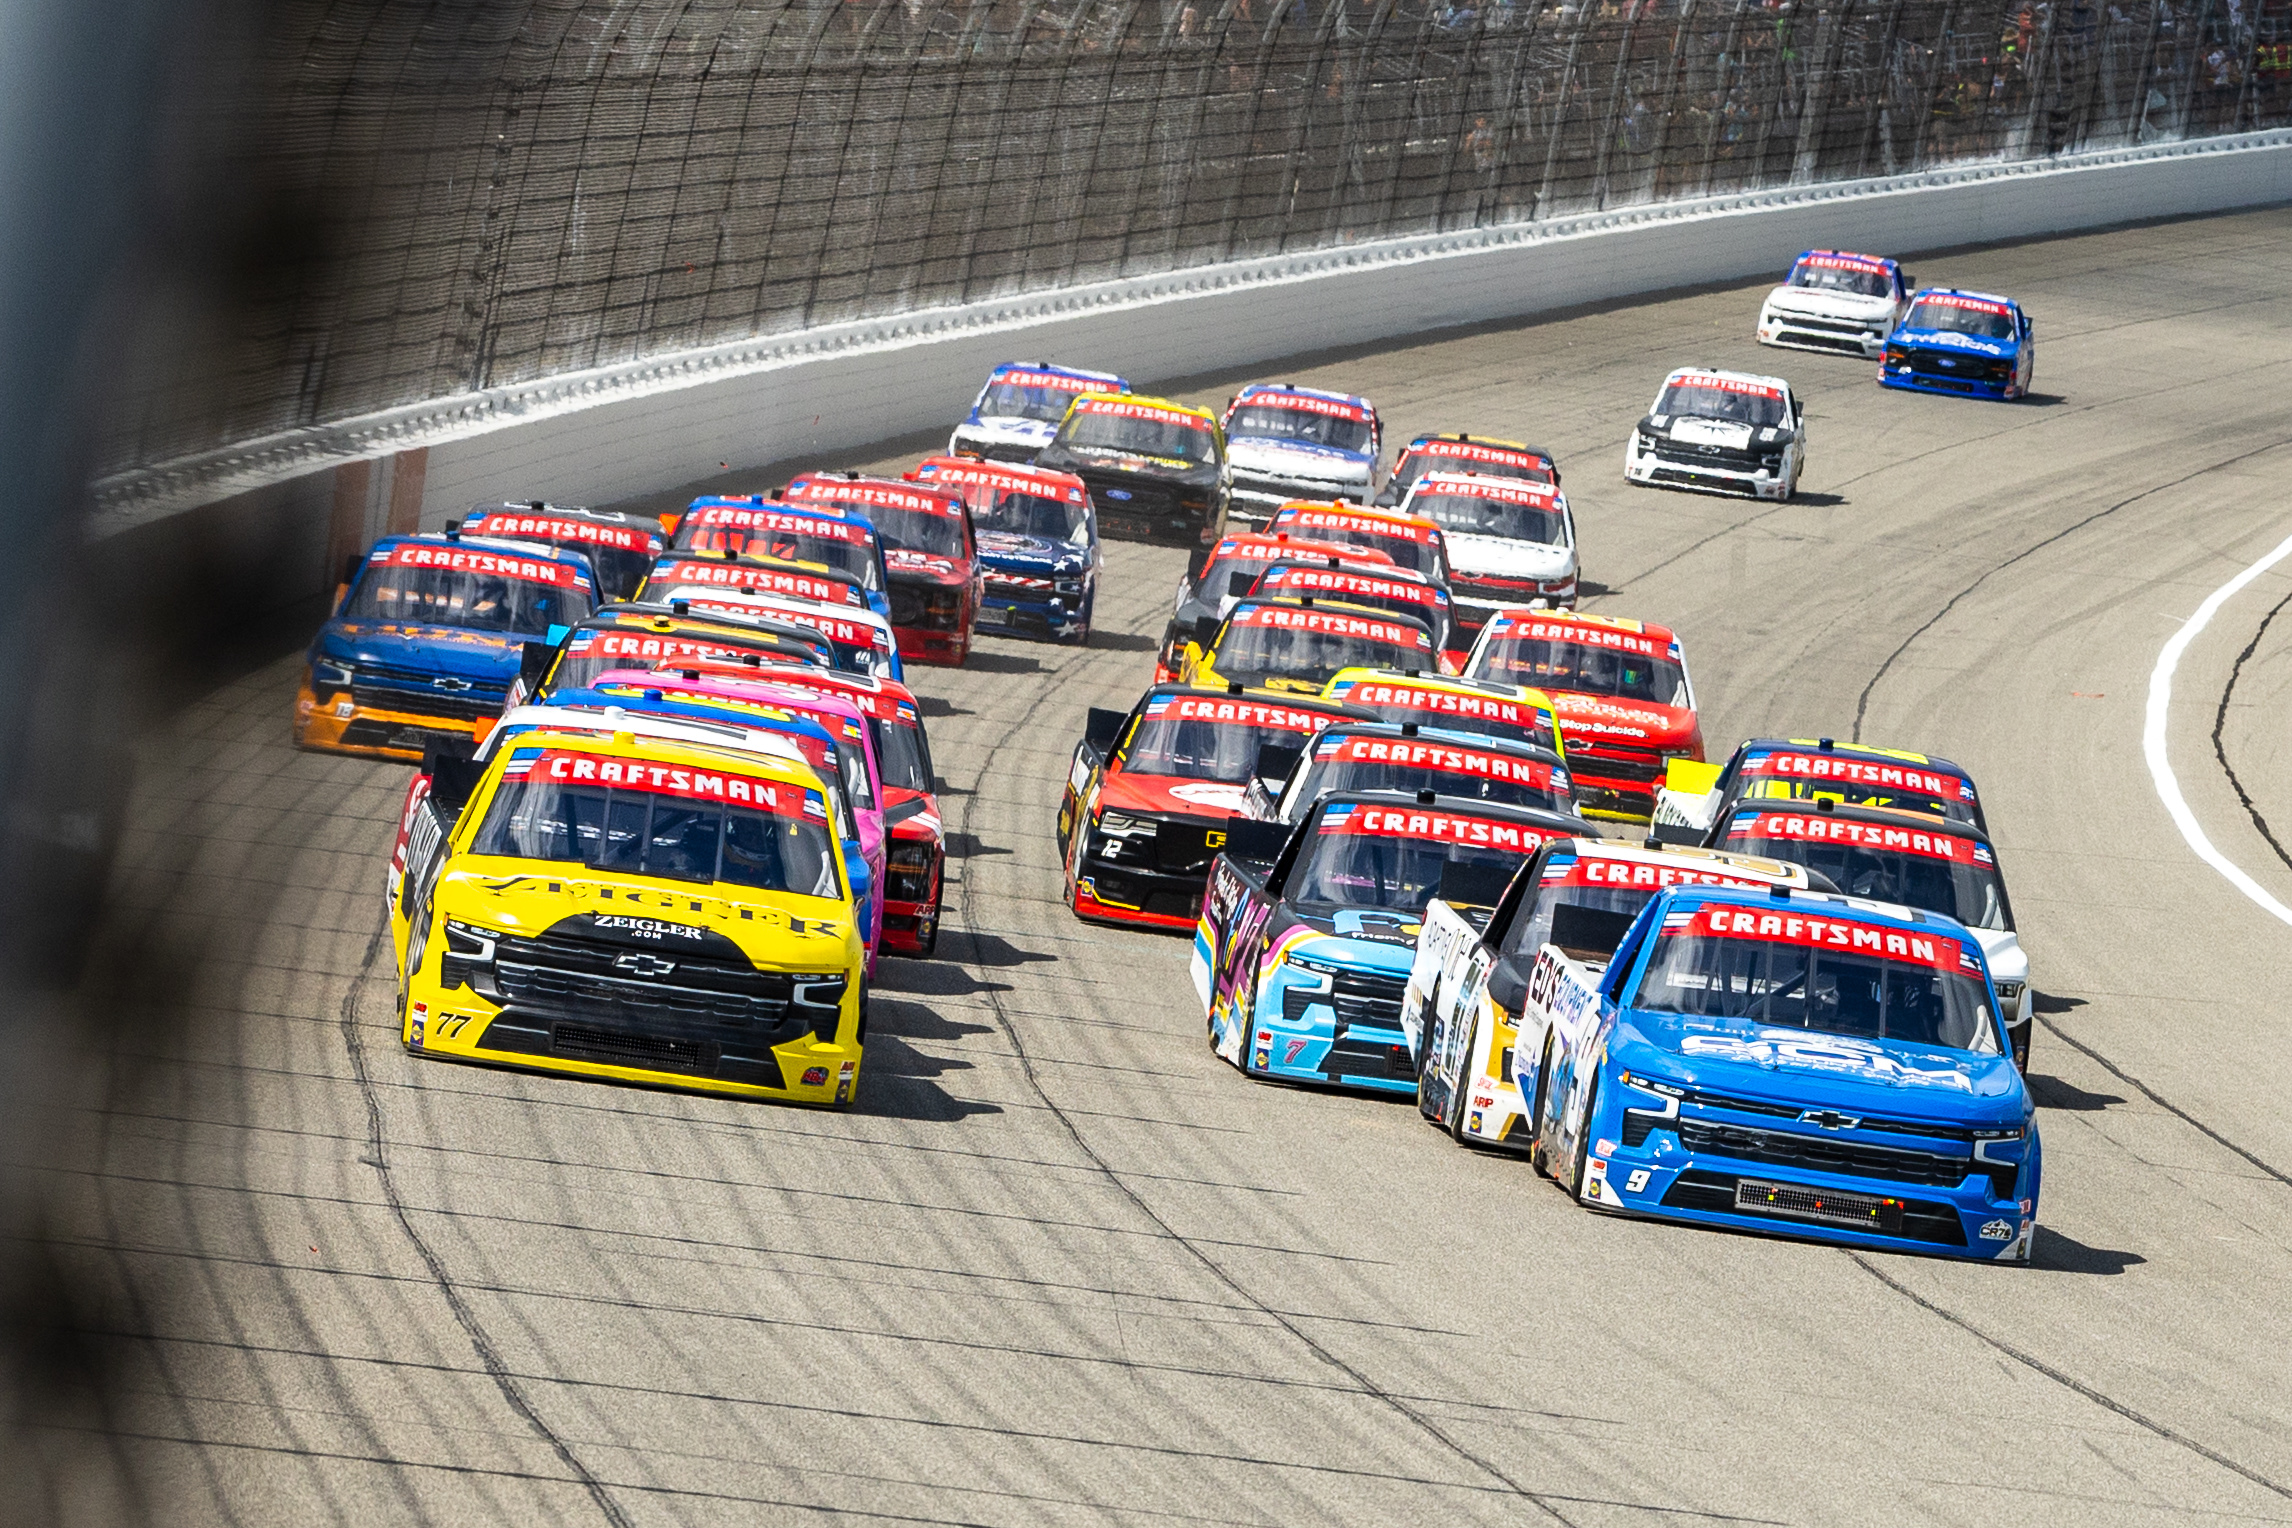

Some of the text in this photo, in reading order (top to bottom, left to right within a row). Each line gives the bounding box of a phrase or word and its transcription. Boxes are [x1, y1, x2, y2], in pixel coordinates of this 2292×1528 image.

[1811, 257, 1879, 273] CRAFTSMAN
[1928, 296, 1999, 312] CRAFTSMAN
[1010, 372, 1107, 393] CRAFTSMAN
[1684, 375, 1768, 395] CRAFTSMAN
[1093, 401, 1192, 426] CRAFTSMAN
[1257, 394, 1351, 418] CRAFTSMAN
[1429, 443, 1528, 466] CRAFTSMAN
[940, 469, 1056, 497] CRAFTSMAN
[1436, 481, 1541, 506] CRAFTSMAN
[811, 486, 934, 511] CRAFTSMAN
[489, 517, 632, 547] CRAFTSMAN
[705, 509, 849, 539] CRAFTSMAN
[1300, 513, 1416, 539] CRAFTSMAN
[400, 549, 556, 583] CRAFTSMAN
[680, 565, 830, 599] CRAFTSMAN
[1291, 572, 1421, 600] CRAFTSMAN
[1262, 610, 1401, 642] CRAFTSMAN
[1518, 623, 1653, 654] CRAFTSMAN
[1180, 701, 1339, 731] CRAFTSMA
[1360, 686, 1518, 723] CRAFTSMAN
[1560, 719, 1591, 732] Stop
[1352, 742, 1530, 782] CRAFTSMAN
[1776, 756, 1941, 792] CRAFTSMAN
[550, 757, 778, 807] CRAFTSMAN
[1364, 811, 1556, 850] CRAFTSMA
[1768, 816, 1953, 858] CRAFTSMAN
[1101, 840, 1123, 859] 12
[594, 915, 703, 940] ZEIGLER
[631, 929, 662, 940] .COM
[1709, 911, 1934, 961] CRAFTSMAN
[436, 1011, 473, 1040] 77
[1283, 1038, 1307, 1065] 7
[1625, 1168, 1652, 1194] 9
